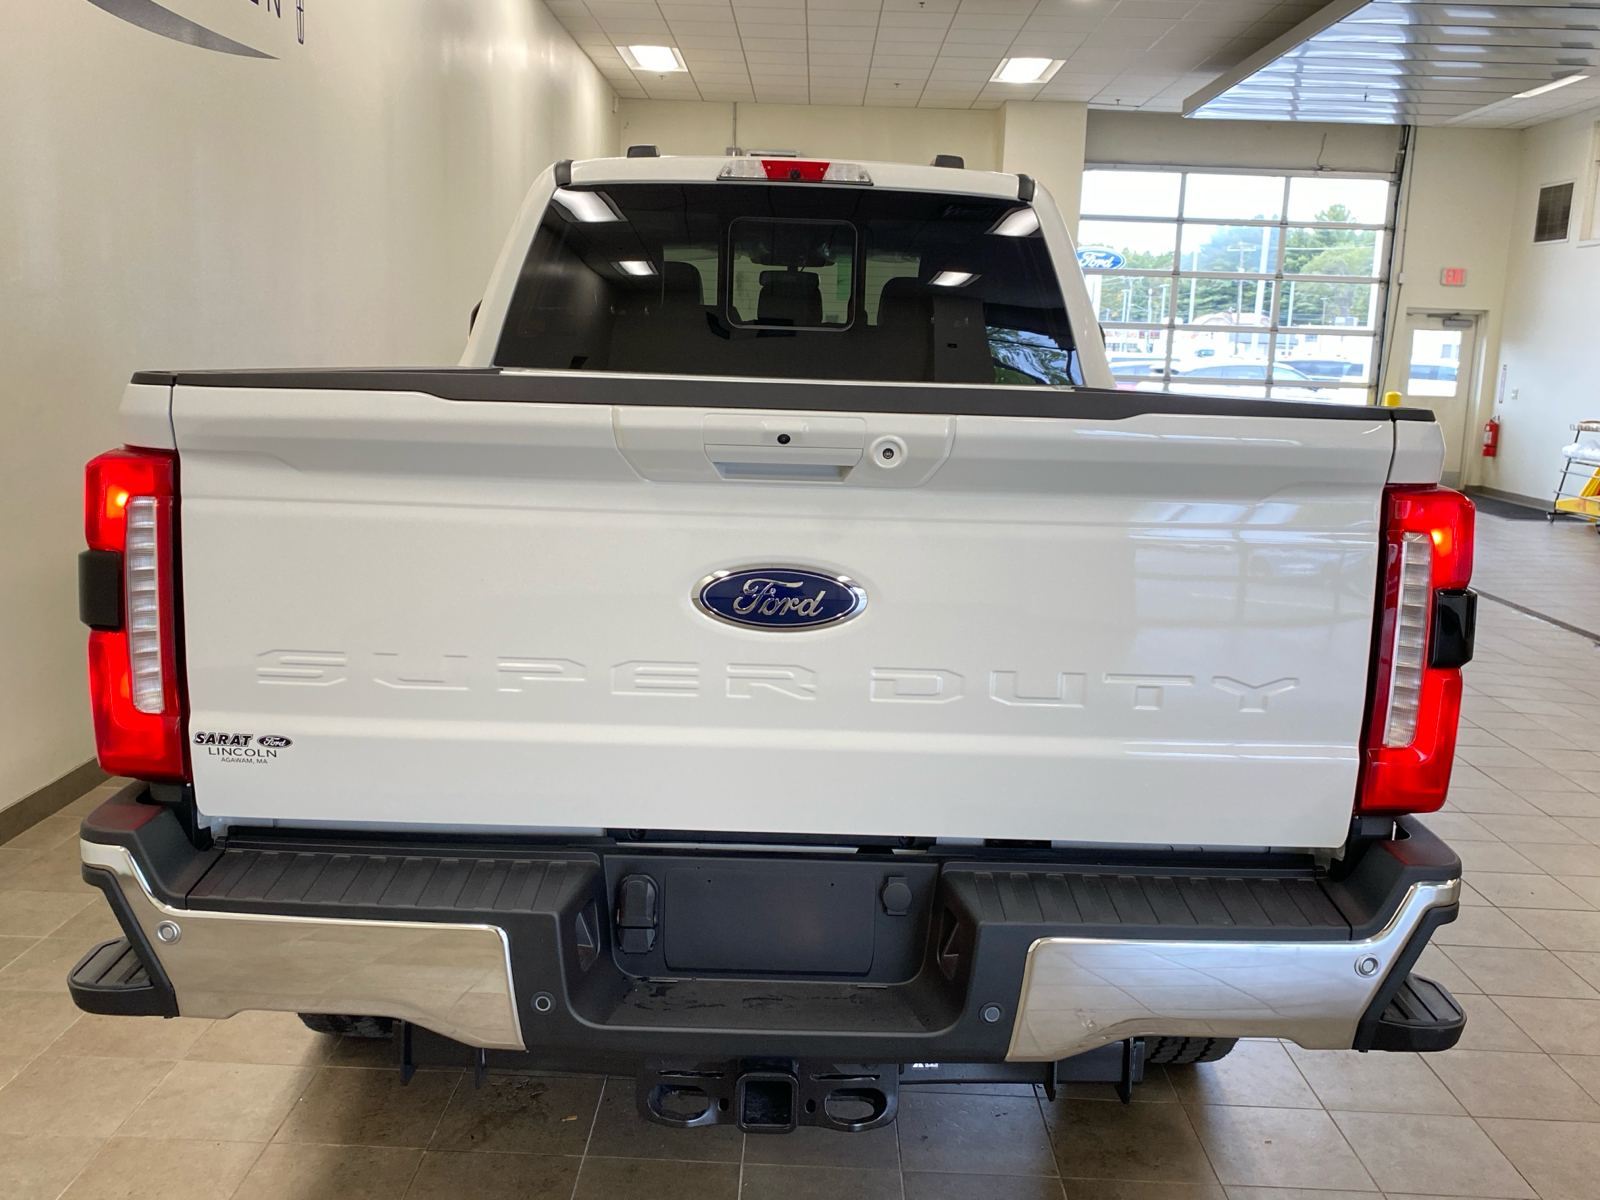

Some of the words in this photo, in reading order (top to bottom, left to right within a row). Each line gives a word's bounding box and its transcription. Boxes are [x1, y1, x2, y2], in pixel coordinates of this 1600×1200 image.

[1079, 251, 1115, 268] Ford
[1445, 268, 1465, 284] EXIT
[732, 578, 827, 617] Ford
[256, 649, 817, 701] SUPER
[869, 667, 1300, 713] DUTY
[193, 731, 253, 747] SARAT
[208, 747, 277, 758] LINCOLN
